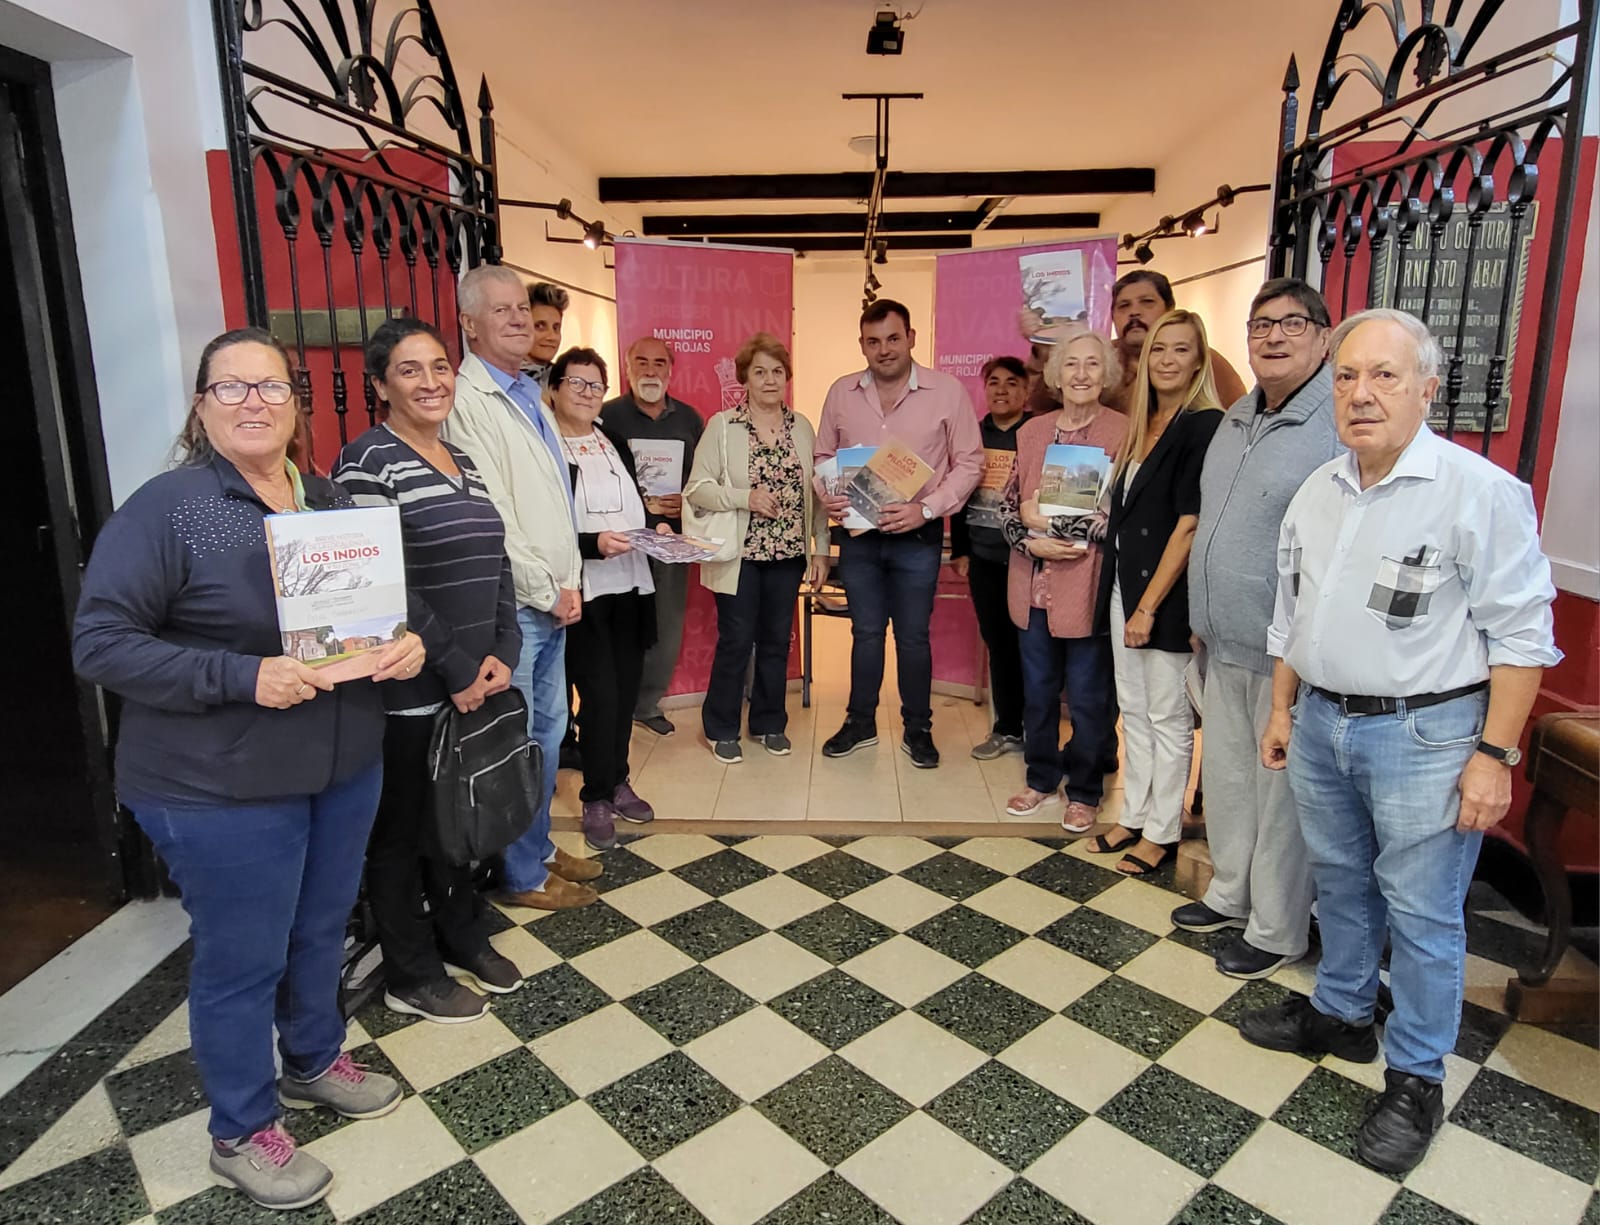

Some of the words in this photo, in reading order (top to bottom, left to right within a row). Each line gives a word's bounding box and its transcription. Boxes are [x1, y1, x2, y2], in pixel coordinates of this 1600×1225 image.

[1032, 271, 1045, 279] LOS
[653, 328, 714, 341] MUNICIPIO
[674, 342, 711, 353] ROJAS
[940, 353, 994, 365] MUNICIPIO
[302, 551, 330, 564] LOS
[333, 546, 380, 561] INDIOS
